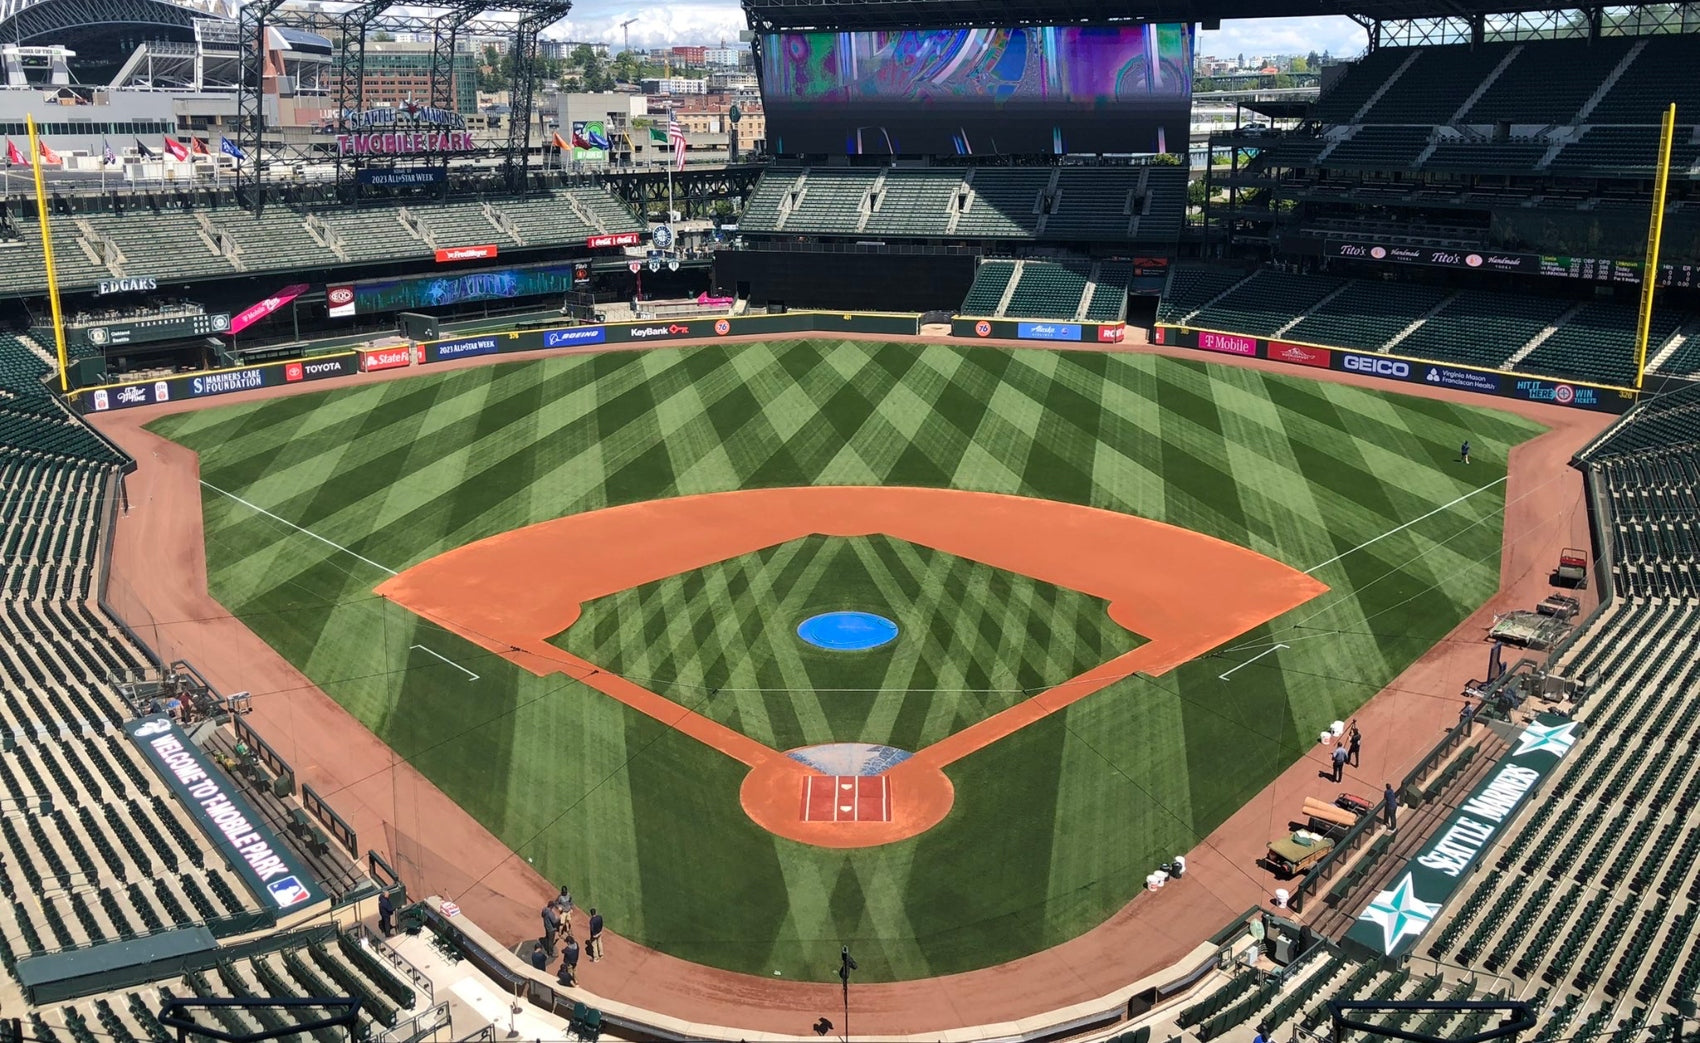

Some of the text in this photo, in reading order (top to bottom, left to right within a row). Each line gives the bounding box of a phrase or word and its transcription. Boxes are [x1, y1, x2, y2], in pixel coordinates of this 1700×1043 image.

[350, 106, 466, 130] SEATTLE MARINERS
[336, 131, 476, 155] T-MOBILE PARK
[372, 175, 388, 184] 2023
[416, 173, 434, 182] WEEK
[1340, 244, 1366, 256] Tito's
[1432, 252, 1460, 264] Tito's
[431, 271, 517, 306] SEATTLE
[562, 330, 599, 340] BOEING
[631, 326, 668, 337] KeyBank
[440, 346, 453, 354] 2023
[478, 340, 494, 350] WEEK
[1216, 336, 1249, 352] Mobile
[379, 354, 400, 364] State
[305, 362, 341, 374] TOYOTA
[1344, 355, 1409, 377] GEICO
[206, 372, 241, 384] MARINERS
[243, 369, 261, 379] CARE
[1442, 369, 1486, 382] Virginia Mason
[206, 377, 262, 392] FOUNDATION
[1442, 377, 1495, 390] Franciscan Health
[1517, 381, 1540, 390] HIT IT
[1530, 389, 1552, 398] HERE
[1575, 389, 1593, 398] WIN
[150, 733, 288, 882] WELCOME TO T-MOBILE PARK
[1416, 762, 1540, 877] SEATTLE MARINERS
